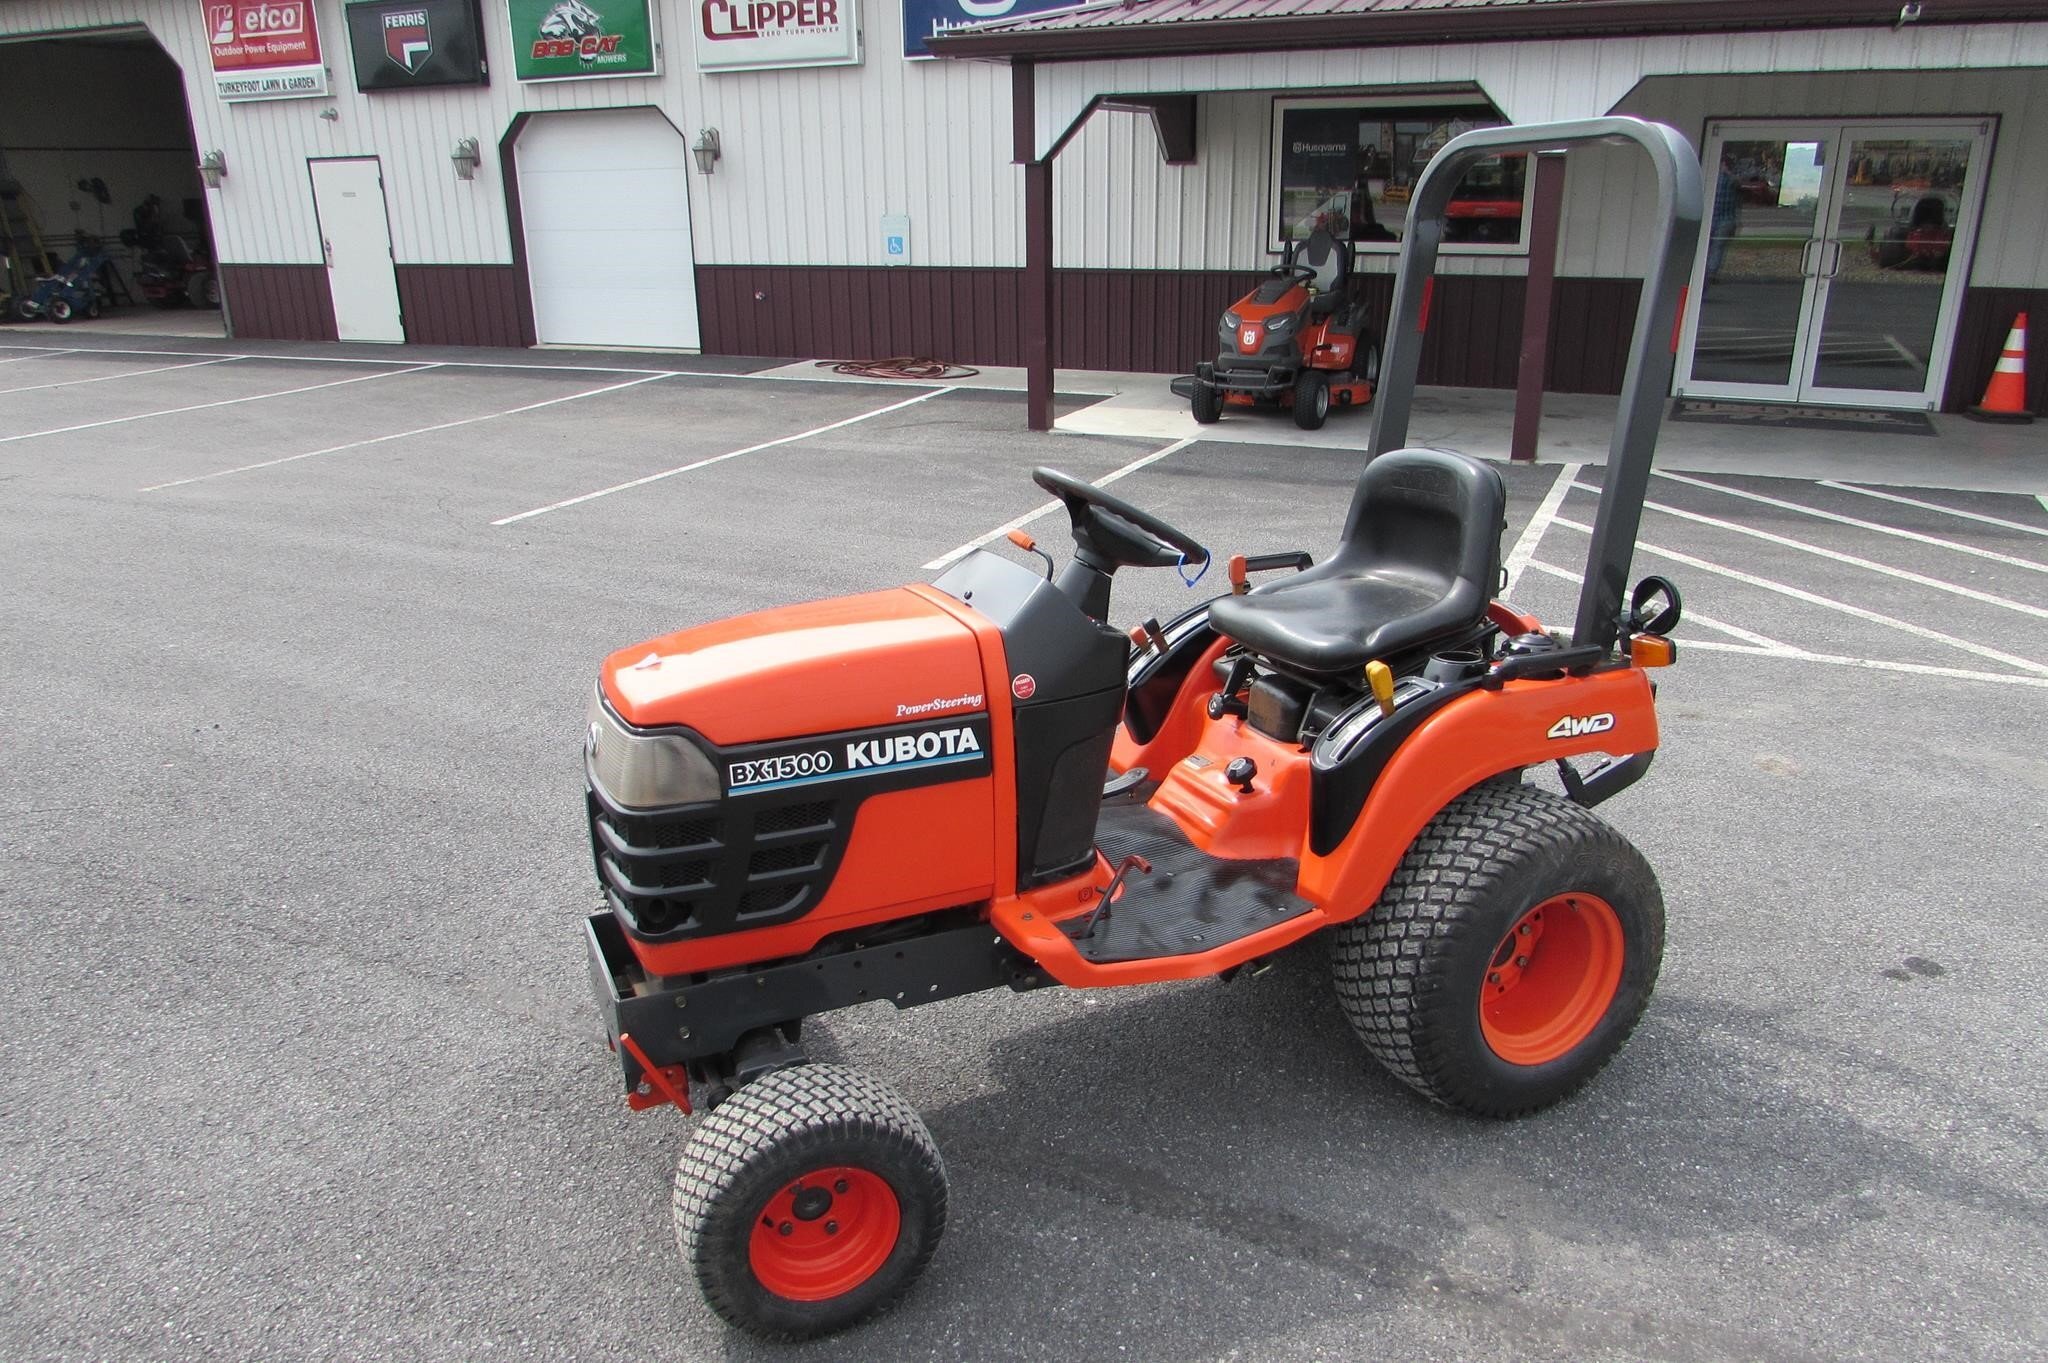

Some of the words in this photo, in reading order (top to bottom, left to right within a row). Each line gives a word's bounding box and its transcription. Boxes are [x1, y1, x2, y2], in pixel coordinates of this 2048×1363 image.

[245, 3, 296, 31] efco
[385, 12, 426, 28] FERRIS
[214, 45, 244, 56] Outdoor
[244, 44, 266, 54] Power
[266, 40, 307, 53] Equipment
[597, 54, 627, 64] MOWERS
[218, 80, 260, 93] TURKEYFOOT
[261, 79, 280, 91] LAWN
[282, 79, 288, 89] &
[288, 77, 316, 89] GARDEN
[896, 693, 983, 717] PowerSteering
[1546, 712, 1616, 740] 4WD
[730, 751, 832, 786] BX1500
[846, 727, 980, 768] KUBOTA
